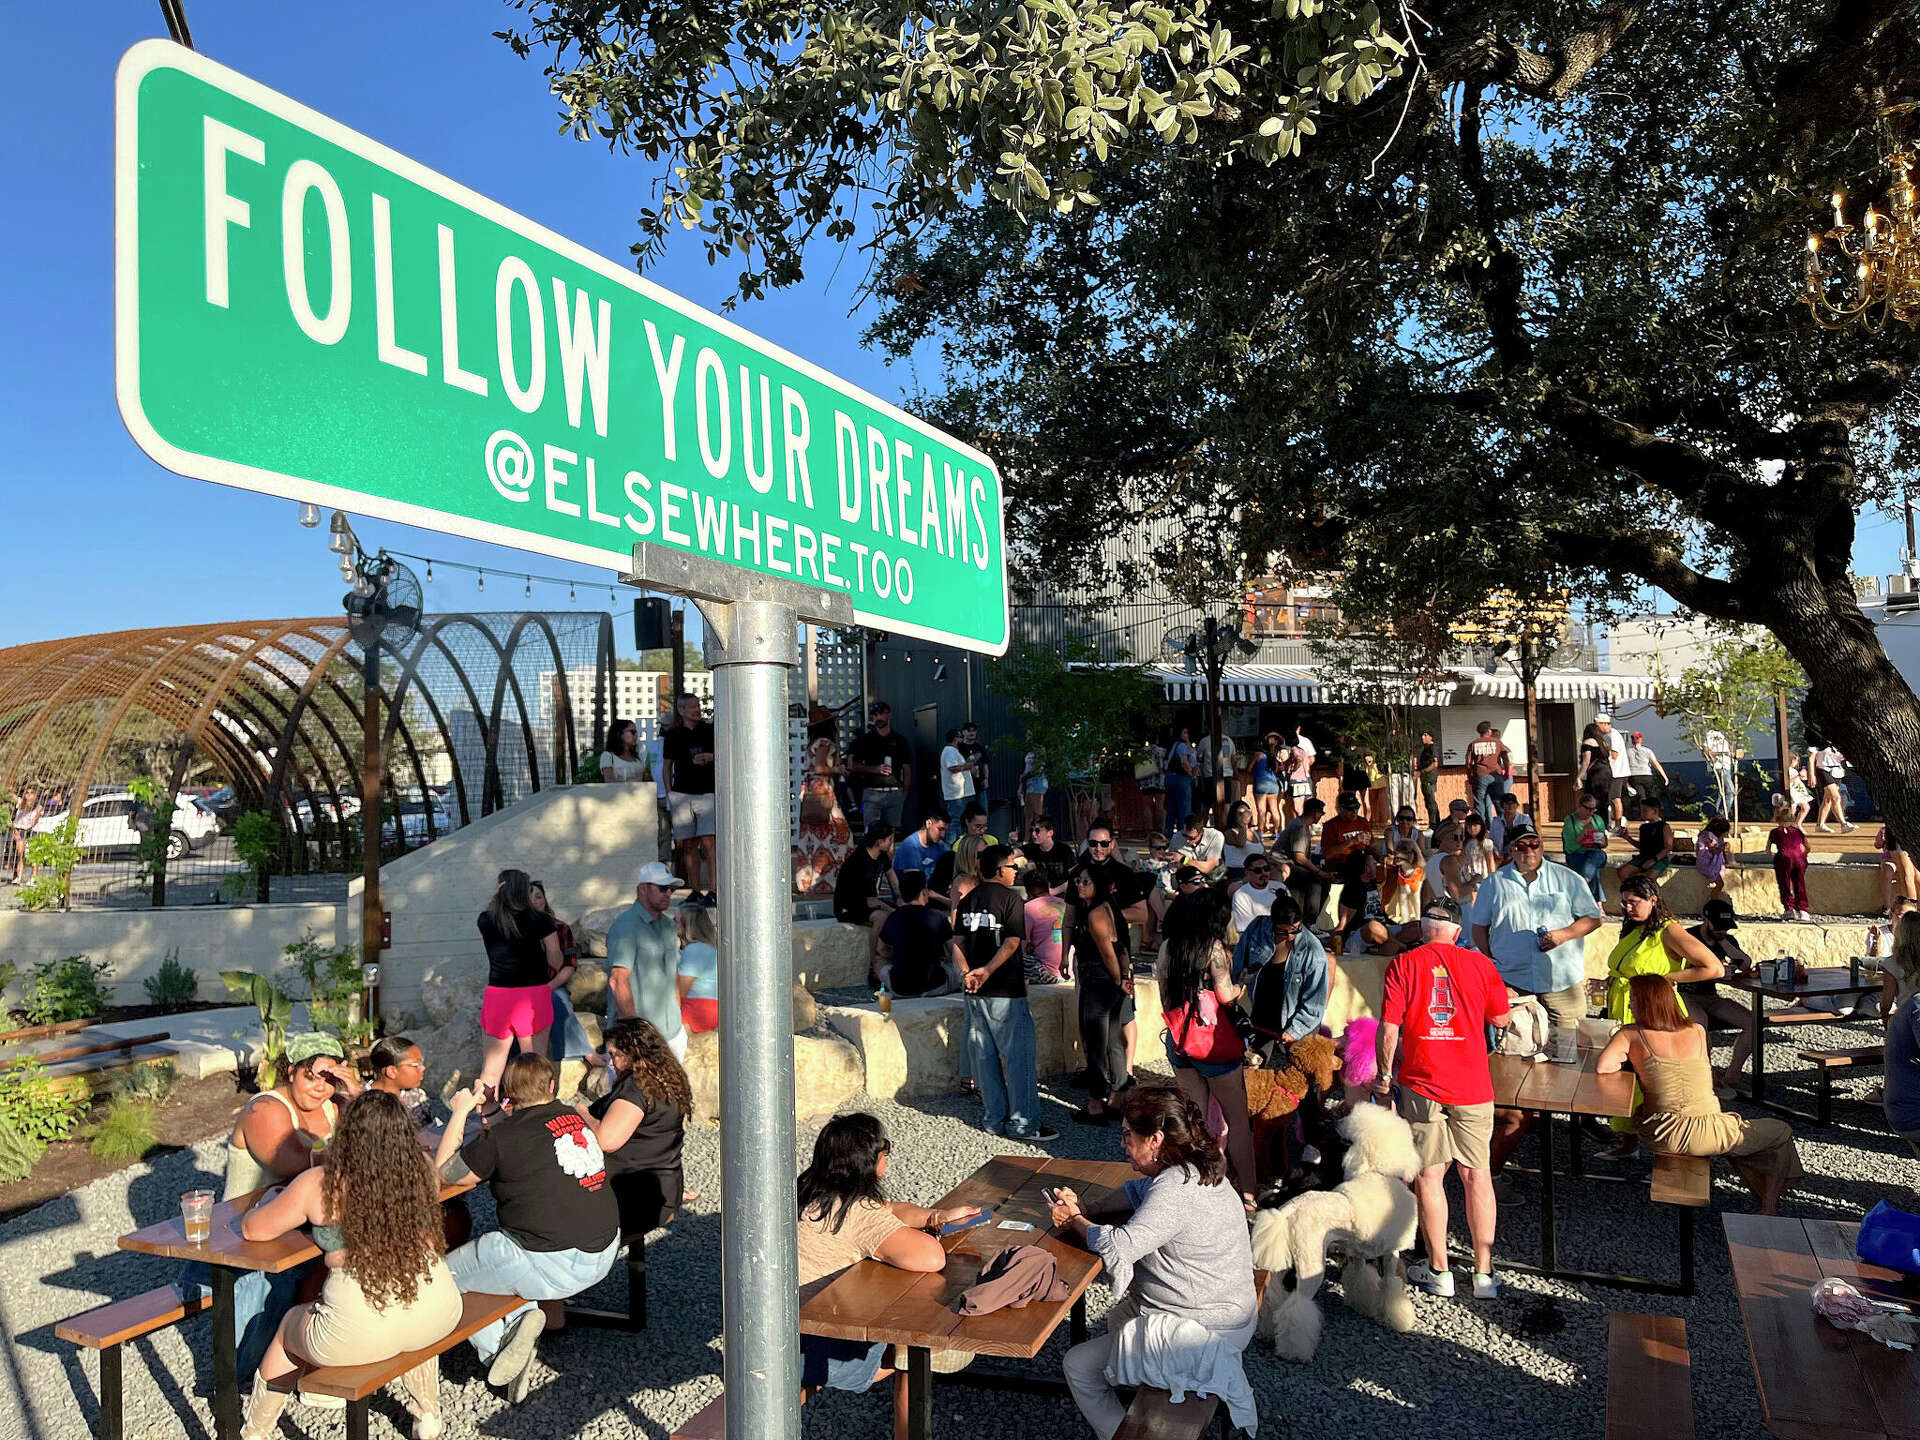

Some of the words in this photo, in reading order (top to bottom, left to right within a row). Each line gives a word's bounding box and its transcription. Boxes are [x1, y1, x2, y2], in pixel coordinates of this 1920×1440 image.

[203, 114, 611, 438] FOLLOW
[643, 319, 815, 510] YOUR
[835, 409, 989, 571] DREAMS
[485, 429, 914, 605] @ELSEWHERE.TOO
